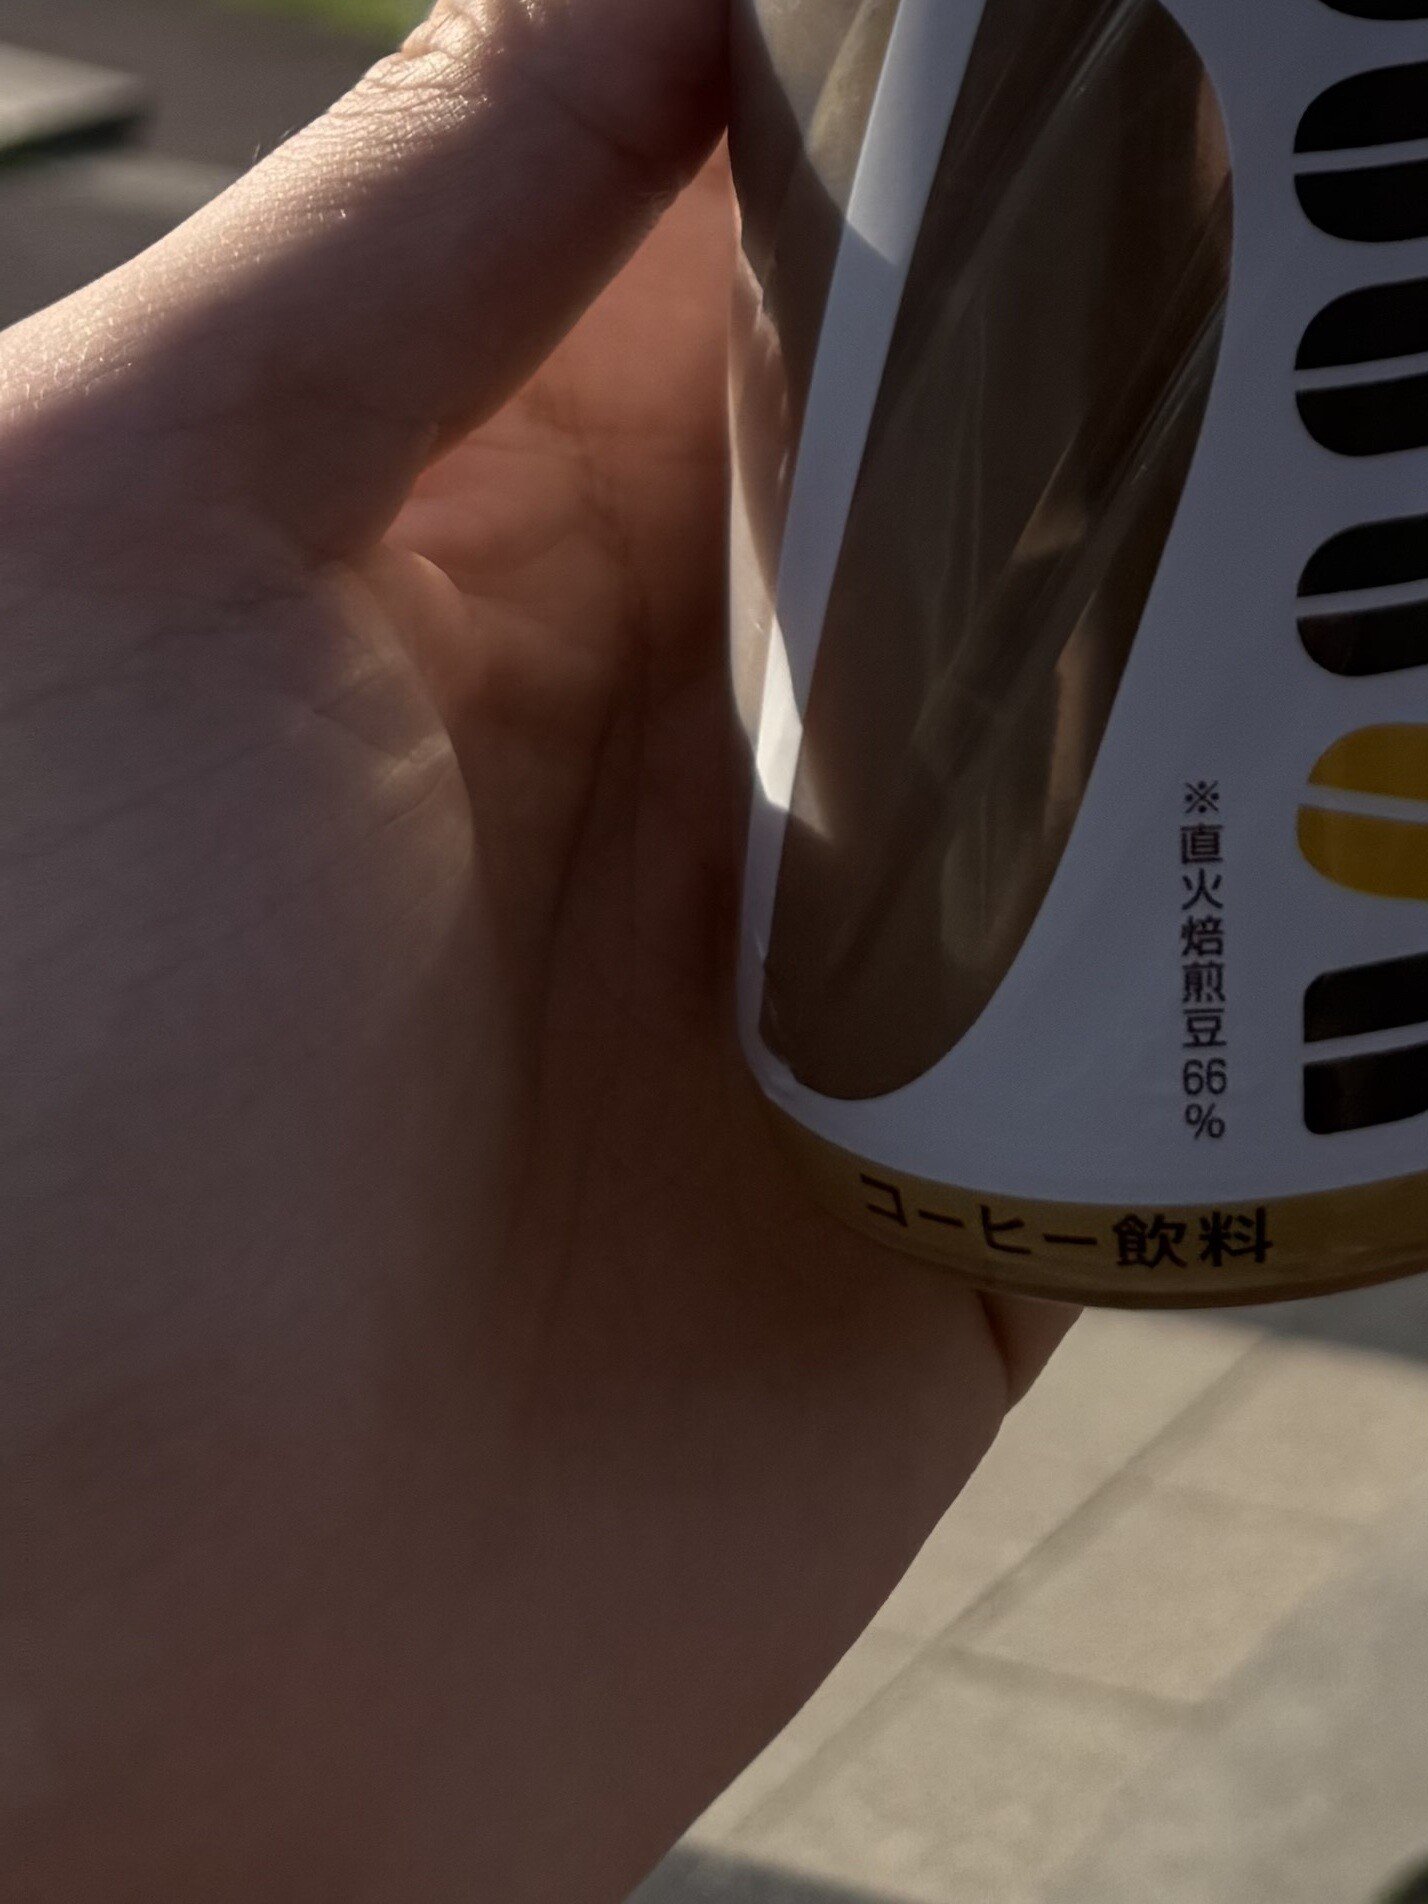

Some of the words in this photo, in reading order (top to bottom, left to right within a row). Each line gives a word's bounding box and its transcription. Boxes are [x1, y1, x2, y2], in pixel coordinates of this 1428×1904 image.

[860, 1172, 1273, 1269] コーヒー飲料
